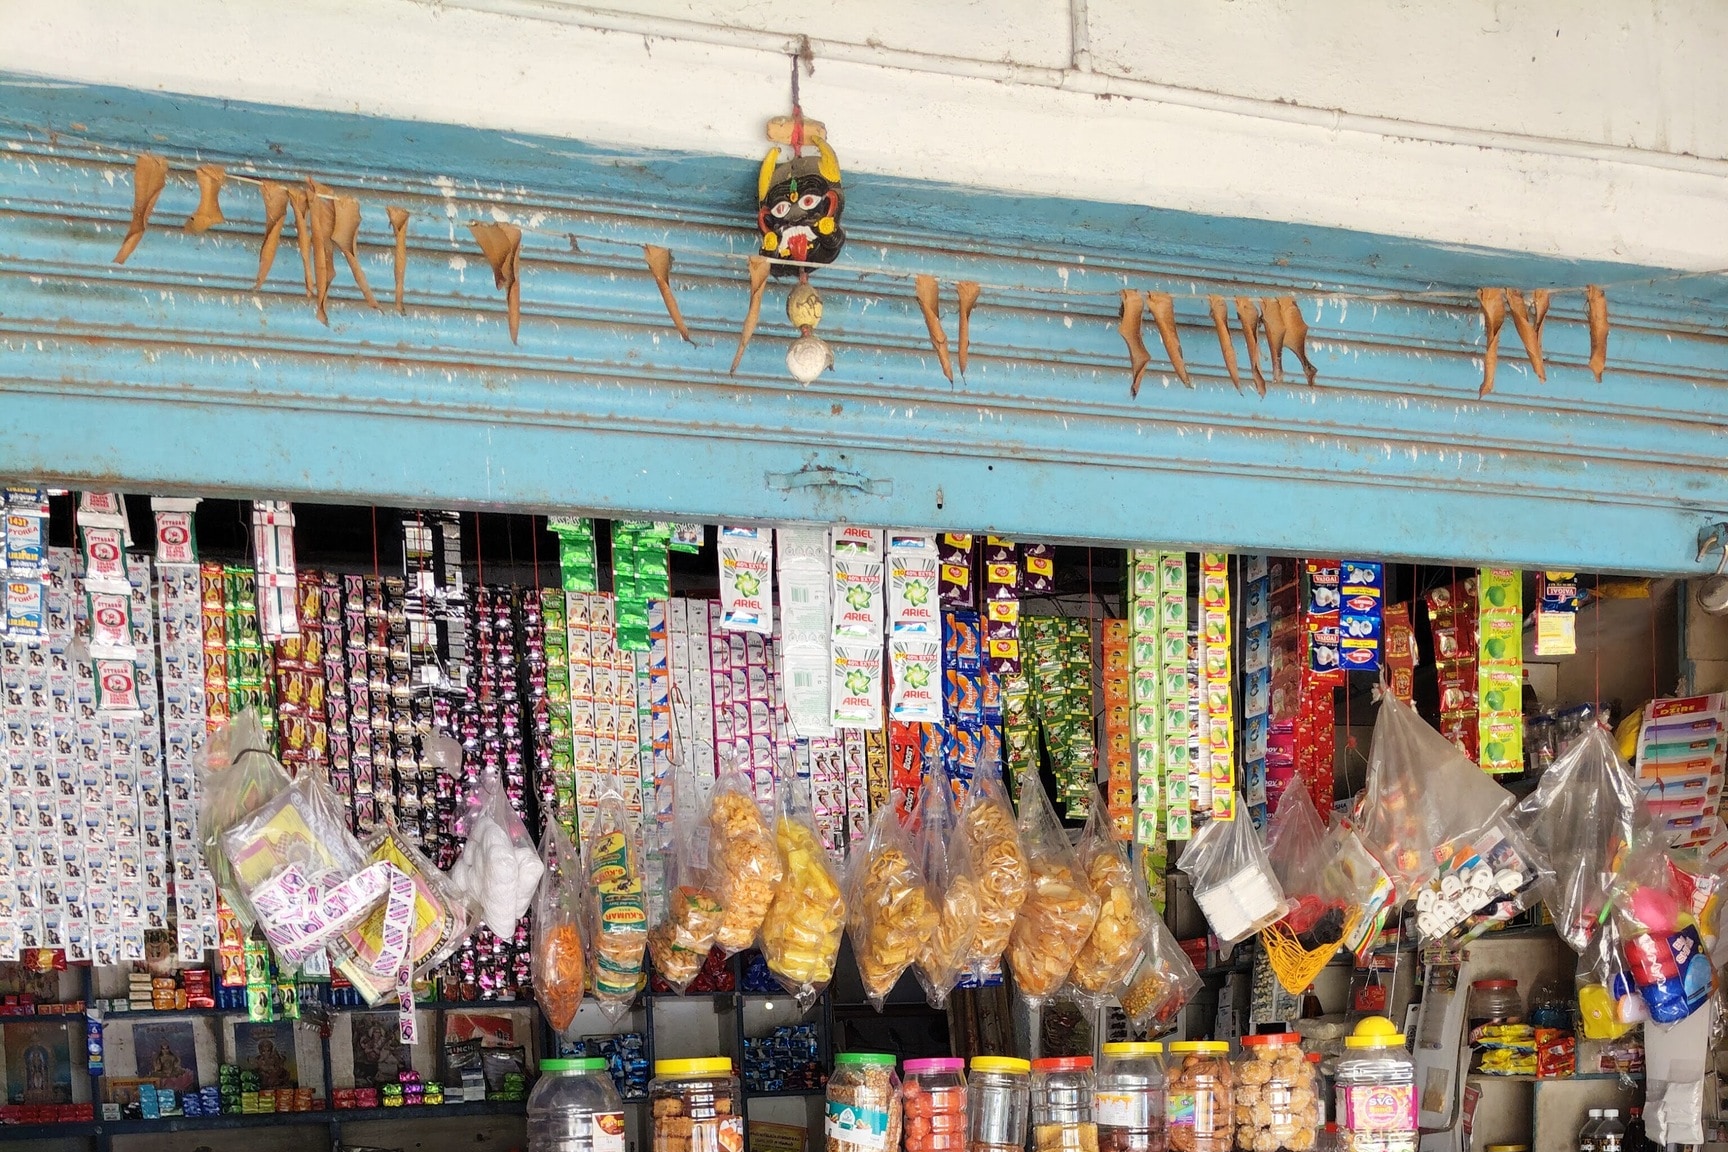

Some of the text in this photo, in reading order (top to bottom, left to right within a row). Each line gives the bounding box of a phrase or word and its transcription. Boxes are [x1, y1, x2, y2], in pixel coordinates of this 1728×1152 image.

[8, 517, 27, 526] 1431
[8, 527, 39, 536] PYOREA
[844, 528, 873, 539] ARIEL
[749, 562, 768, 570] EXTRA
[9, 584, 27, 593] 1431
[8, 594, 39, 603] PYOREA
[733, 599, 762, 610] ARIEL
[844, 612, 873, 622] ARIEL
[902, 608, 931, 617] ARIEL
[903, 690, 931, 699] ARIEL
[842, 697, 872, 707] ARIEL
[1660, 705, 1695, 715] DZIRE
[903, 746, 914, 770] BOOST
[904, 788, 915, 813] BOOST
[606, 911, 644, 922] S.KUMAR
